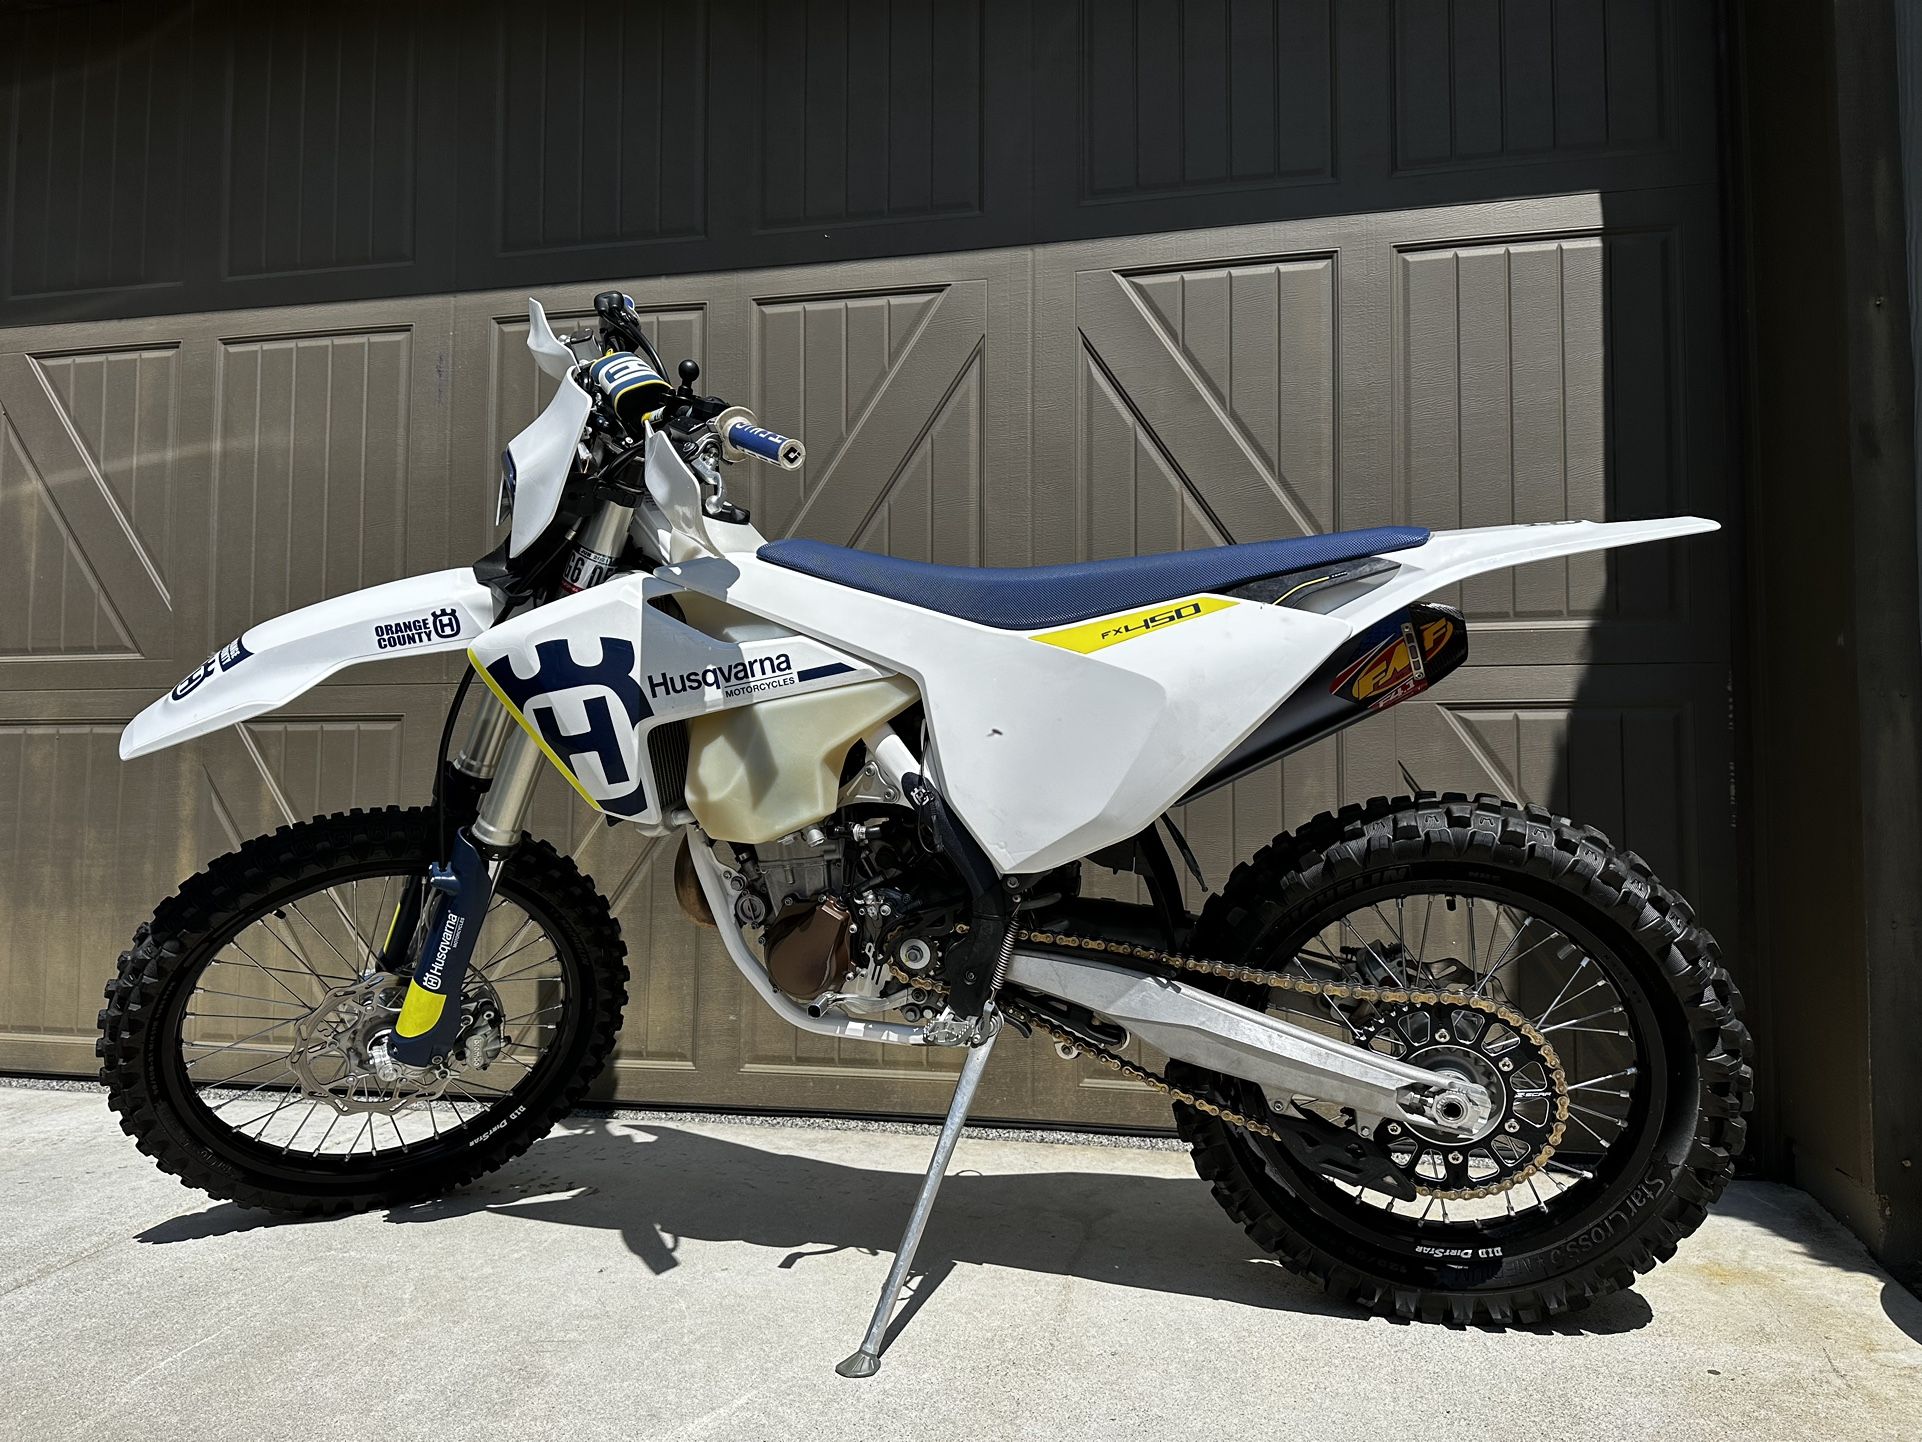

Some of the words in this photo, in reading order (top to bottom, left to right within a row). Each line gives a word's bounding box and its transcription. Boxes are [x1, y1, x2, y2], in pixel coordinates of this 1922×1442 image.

[374, 618, 431, 637] ORANGE
[377, 630, 432, 649] COUNTY
[647, 653, 792, 698] Husqvarna
[725, 677, 795, 698] MOTORCYCLES
[453, 917, 465, 948] MOTORCYCLES
[430, 913, 458, 976] Husqvarna
[509, 1105, 527, 1120] DID
[1478, 1246, 1503, 1258] DID
